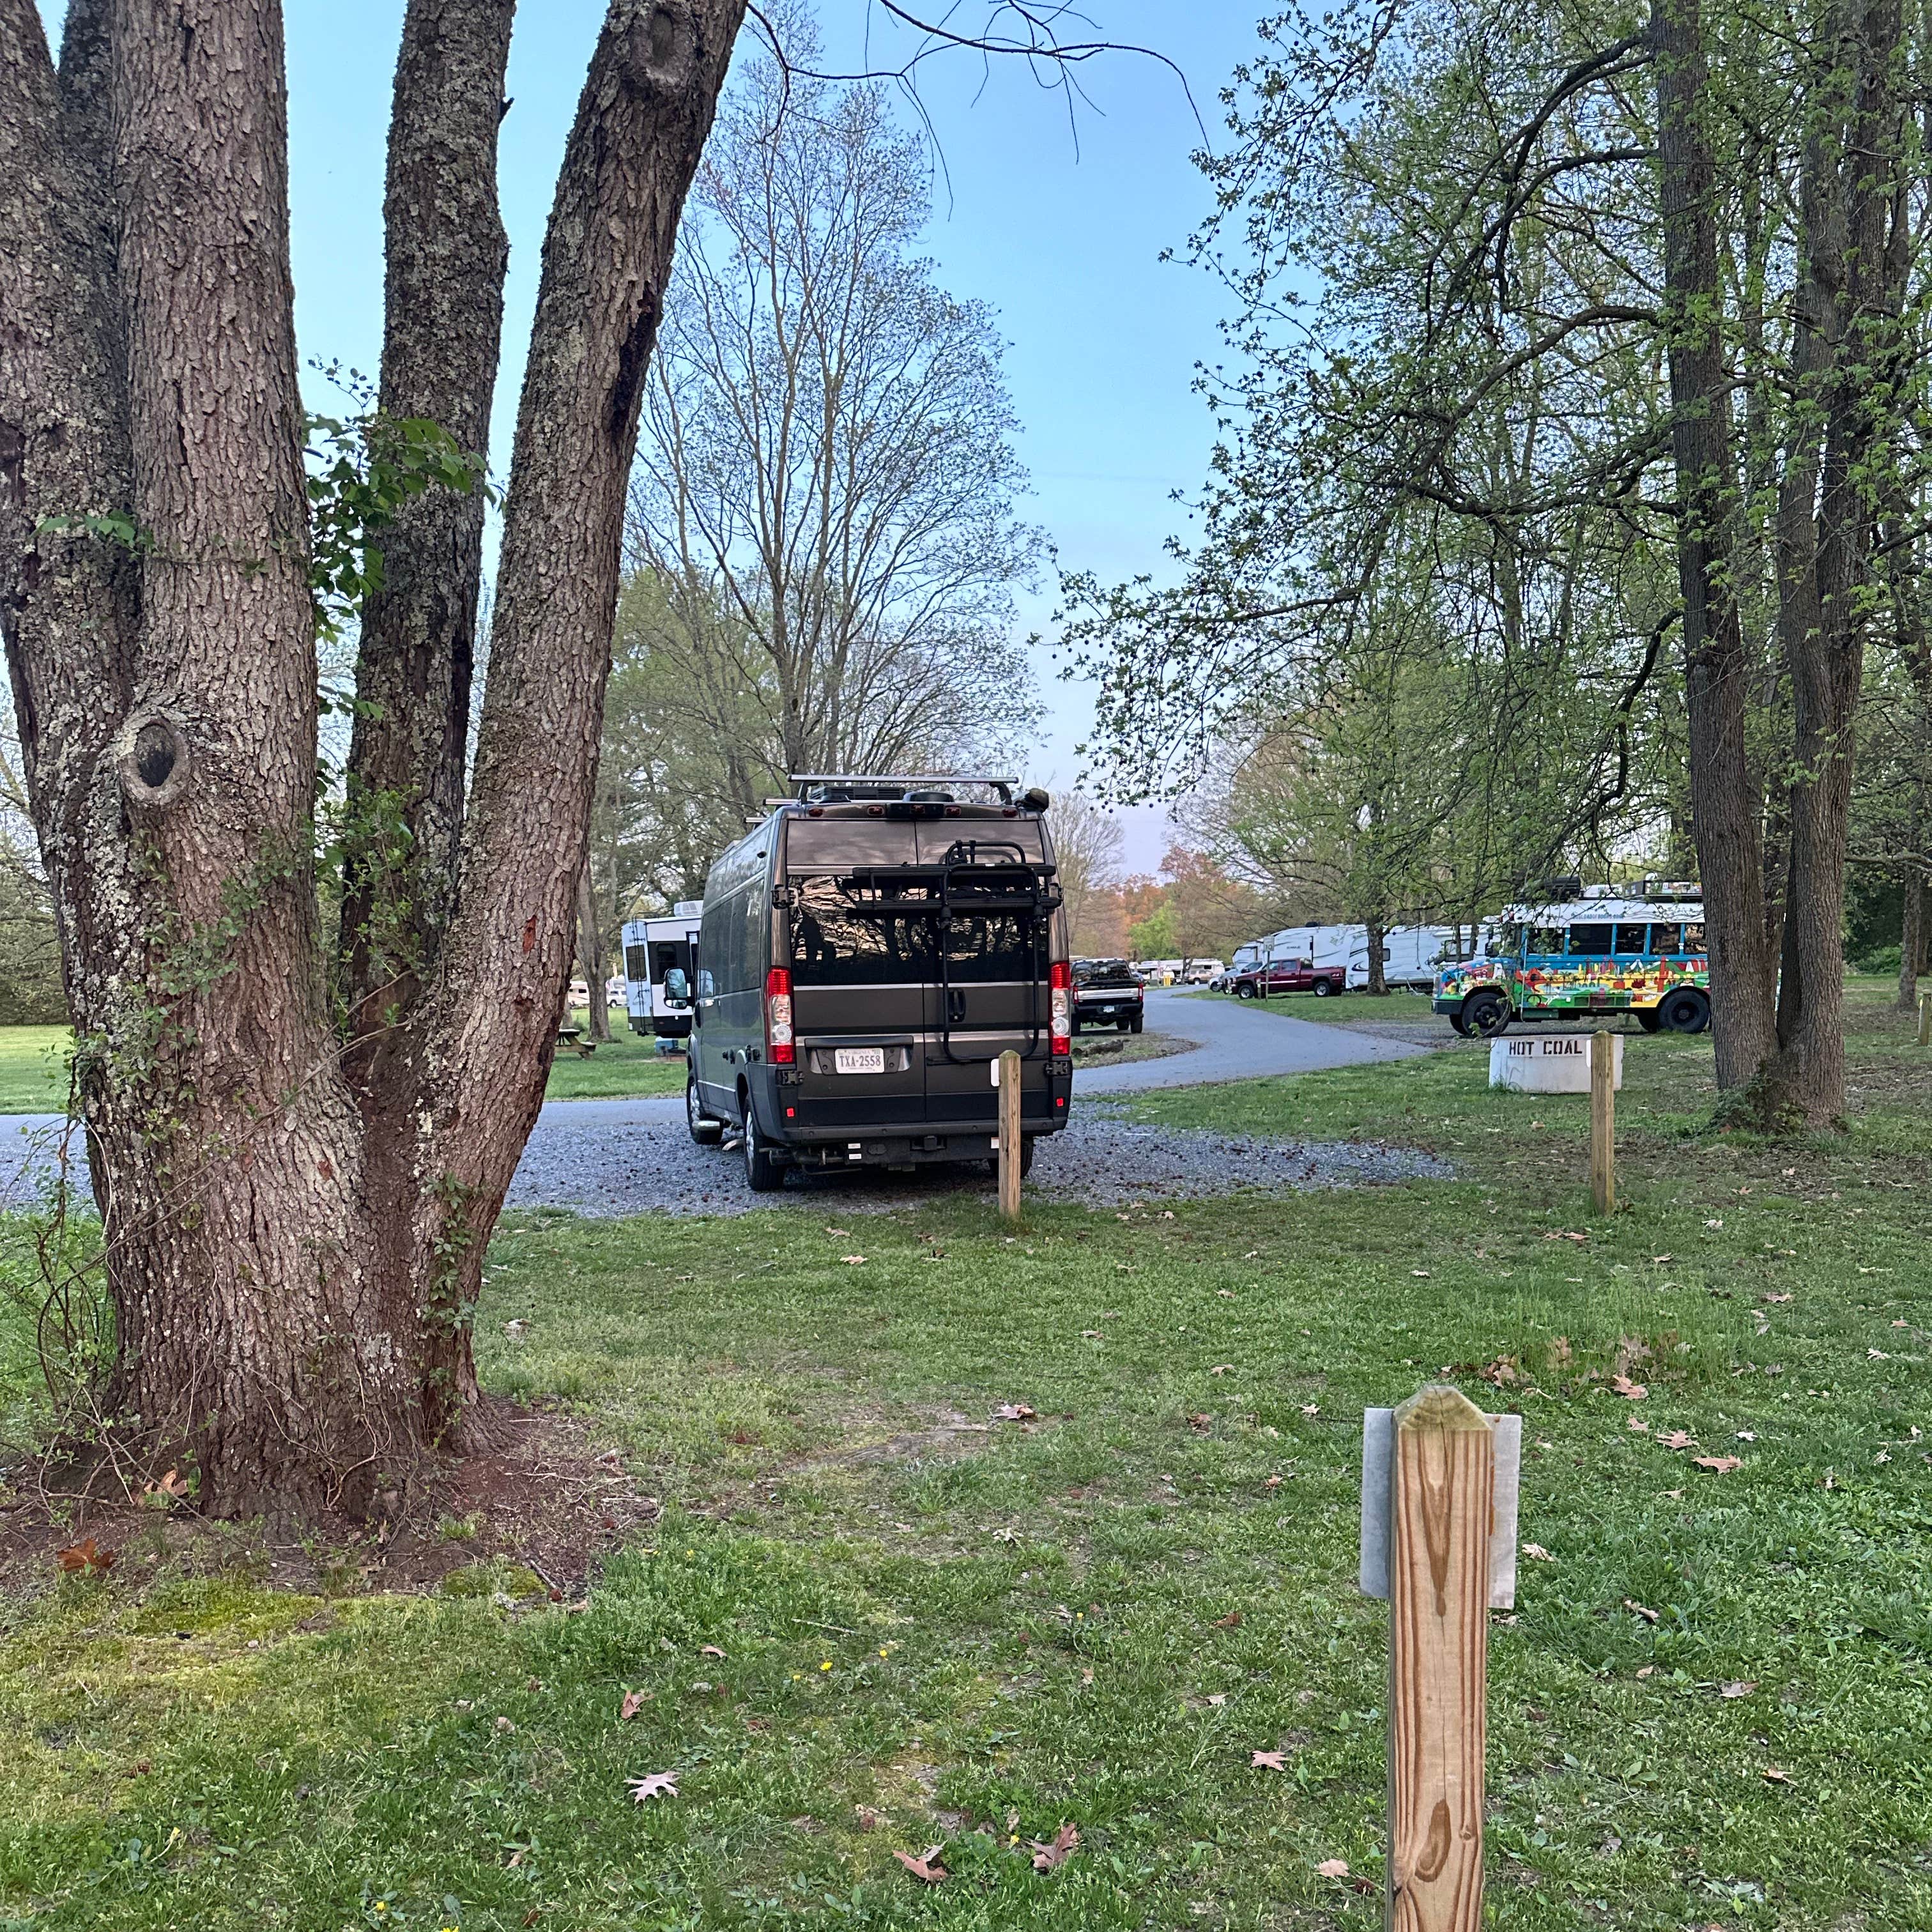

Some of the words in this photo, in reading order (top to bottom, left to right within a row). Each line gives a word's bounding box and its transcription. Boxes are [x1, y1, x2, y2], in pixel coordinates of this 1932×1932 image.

[1509, 1041, 1535, 1055] HOT
[1544, 1040, 1583, 1054] COAL
[839, 1055, 881, 1067] TXA-2558
